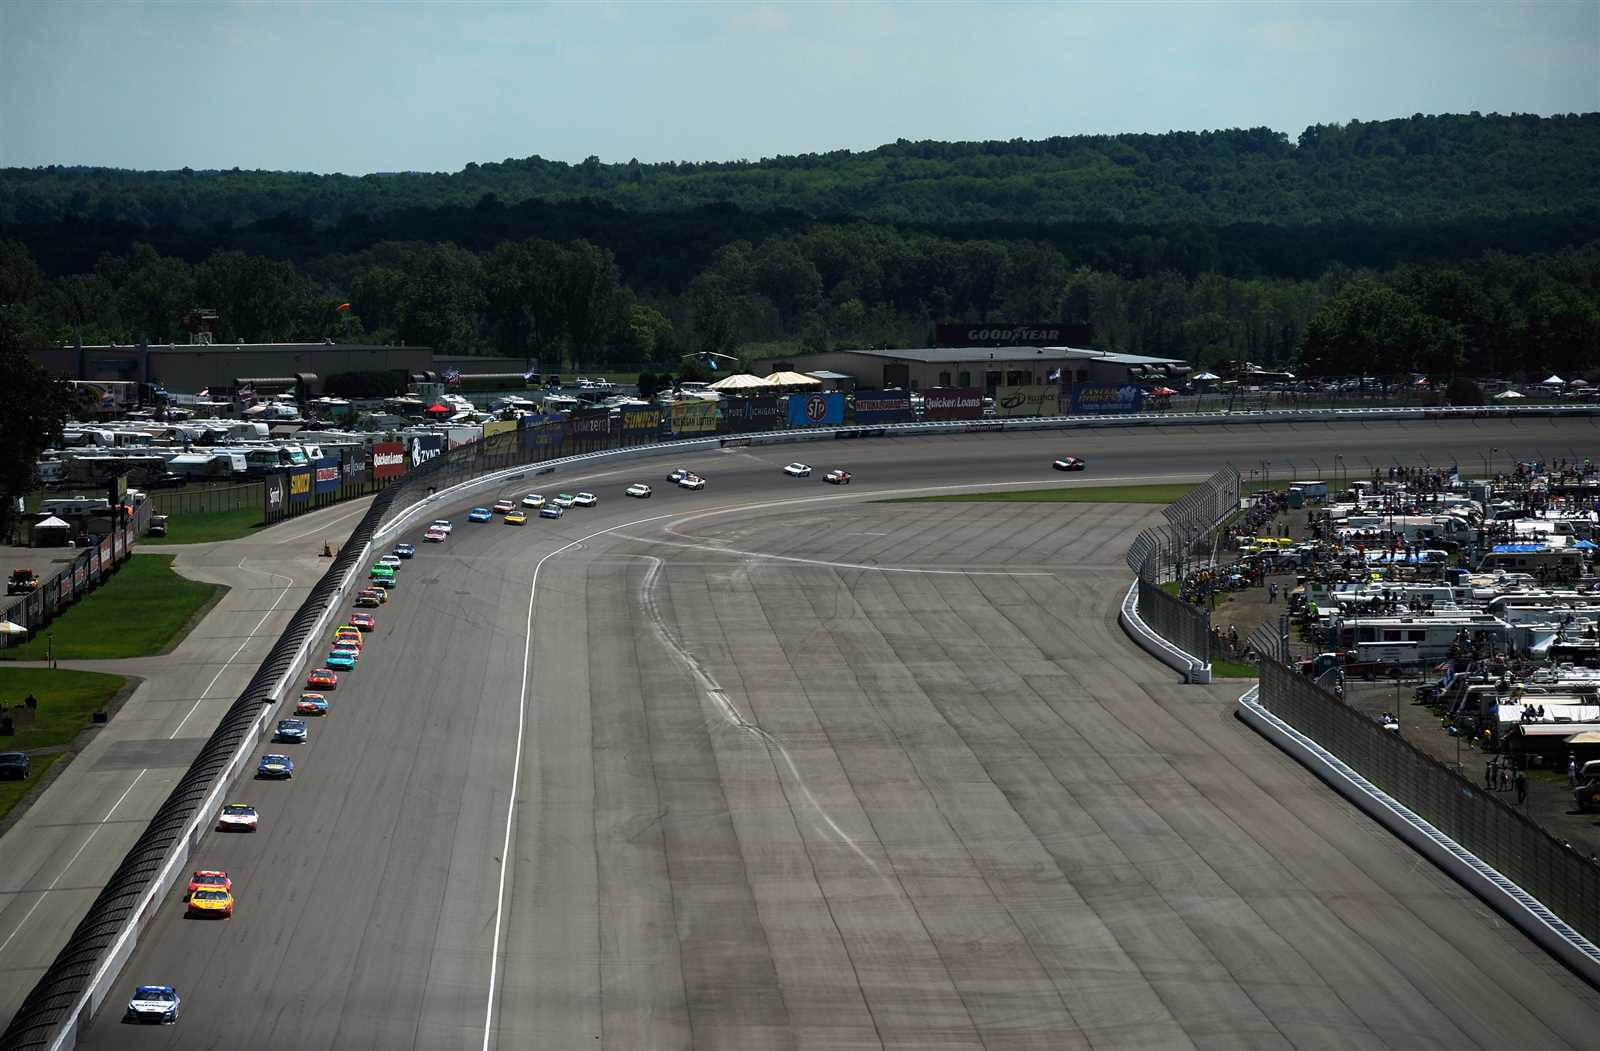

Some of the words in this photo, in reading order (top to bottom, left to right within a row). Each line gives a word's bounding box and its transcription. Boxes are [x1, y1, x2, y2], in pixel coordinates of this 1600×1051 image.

[967, 328, 1060, 342] GOODYEAR
[807, 398, 826, 418] STP
[957, 397, 981, 408] Loans
[623, 410, 660, 429] SUNOCO
